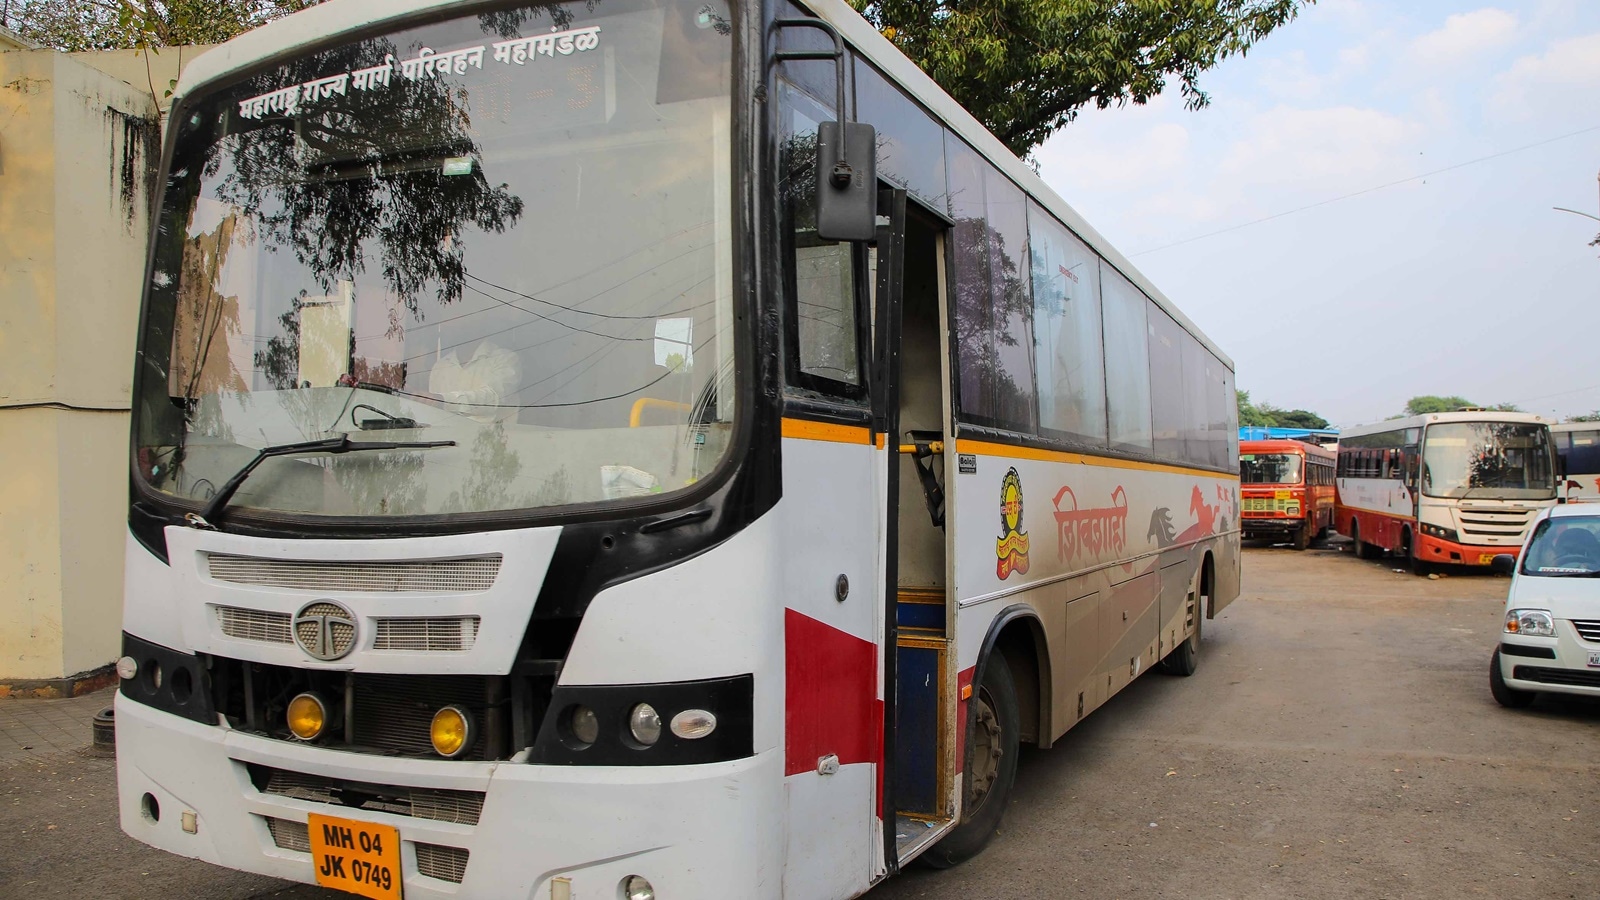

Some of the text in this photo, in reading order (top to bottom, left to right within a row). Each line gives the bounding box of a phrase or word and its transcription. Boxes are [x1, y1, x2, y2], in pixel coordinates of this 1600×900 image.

[238, 25, 601, 120] महाराष्ट्र राज्य मार्ग परिवहन महामंडळ
[322, 824, 383, 856] MH 04
[320, 854, 391, 890] JK 0749
